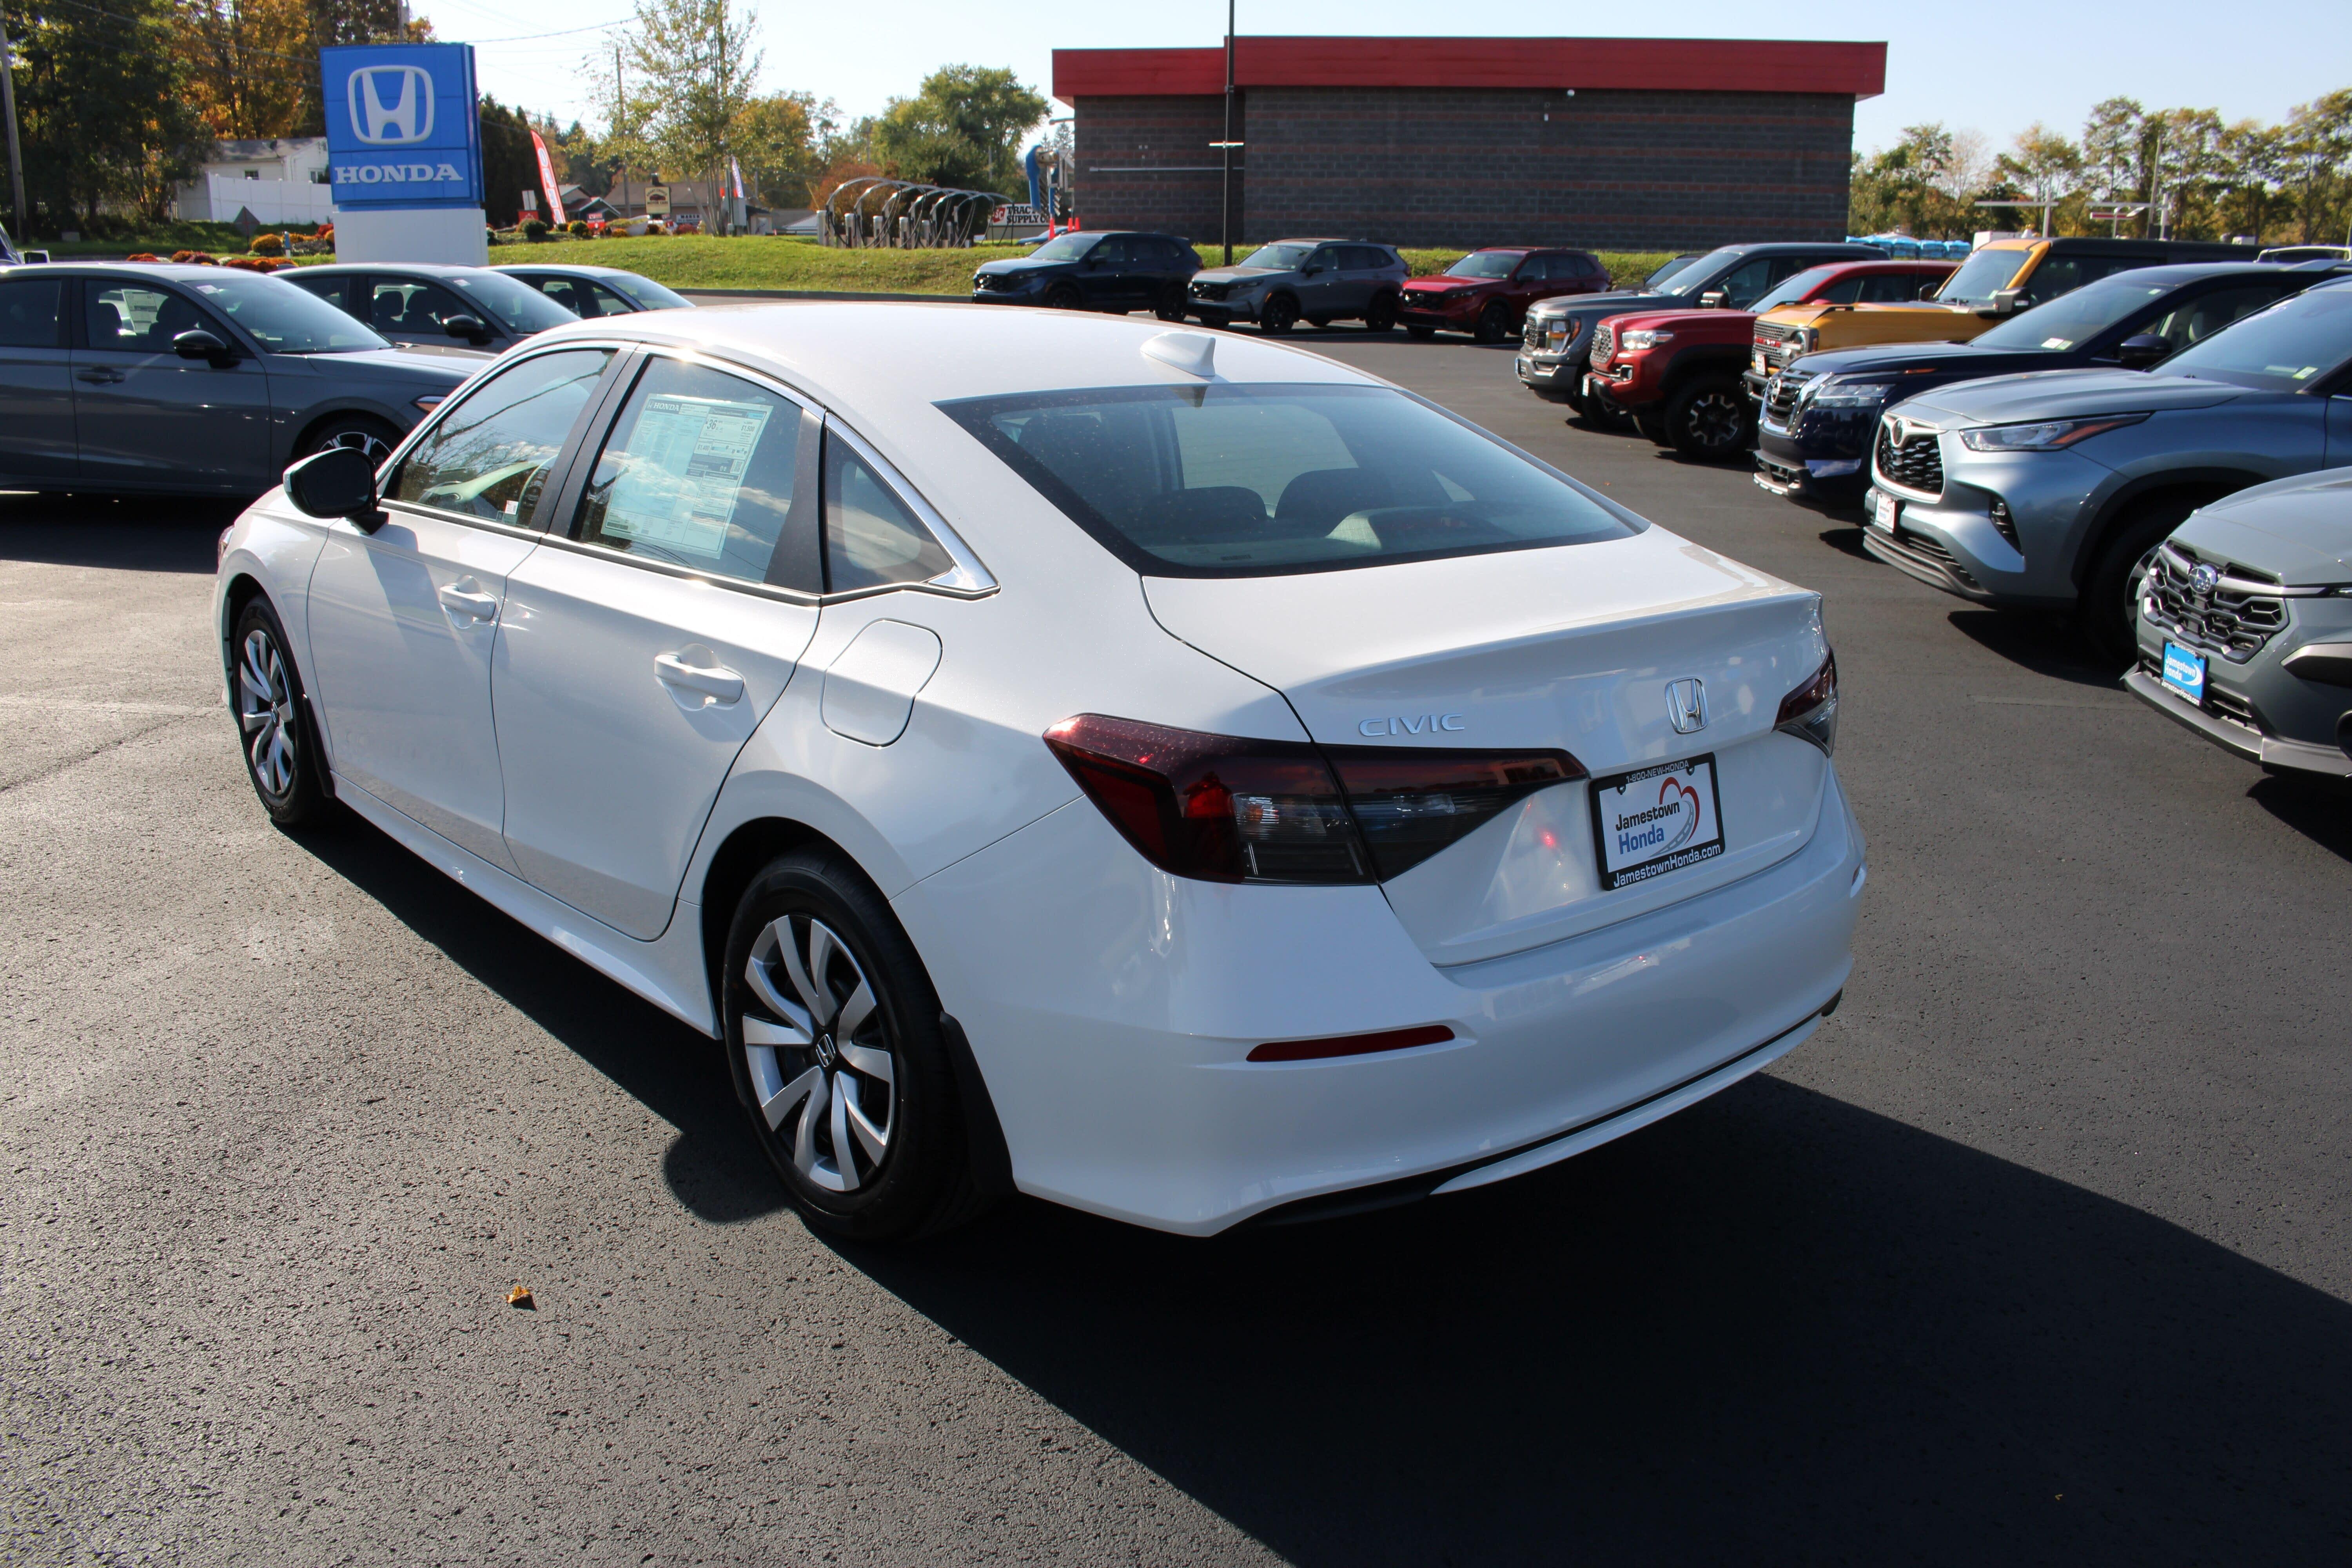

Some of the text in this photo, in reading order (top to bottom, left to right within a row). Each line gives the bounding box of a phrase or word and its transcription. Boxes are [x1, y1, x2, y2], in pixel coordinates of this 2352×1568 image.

[334, 164, 463, 184] HONDA
[538, 147, 564, 224] OPEN
[653, 402, 679, 411] HONDA
[707, 419, 717, 430] 36
[2165, 664, 2183, 681] Honda
[2166, 654, 2196, 677] Jamestown
[2161, 679, 2200, 706] JamestownHonda.com
[1359, 713, 1465, 737] CIVIC
[1626, 760, 1690, 784] 1-800-NEW-HONDA
[1615, 801, 1680, 831] Jamestown
[1618, 824, 1664, 855] Honda
[1613, 844, 1720, 887] JamestownHonda.com
